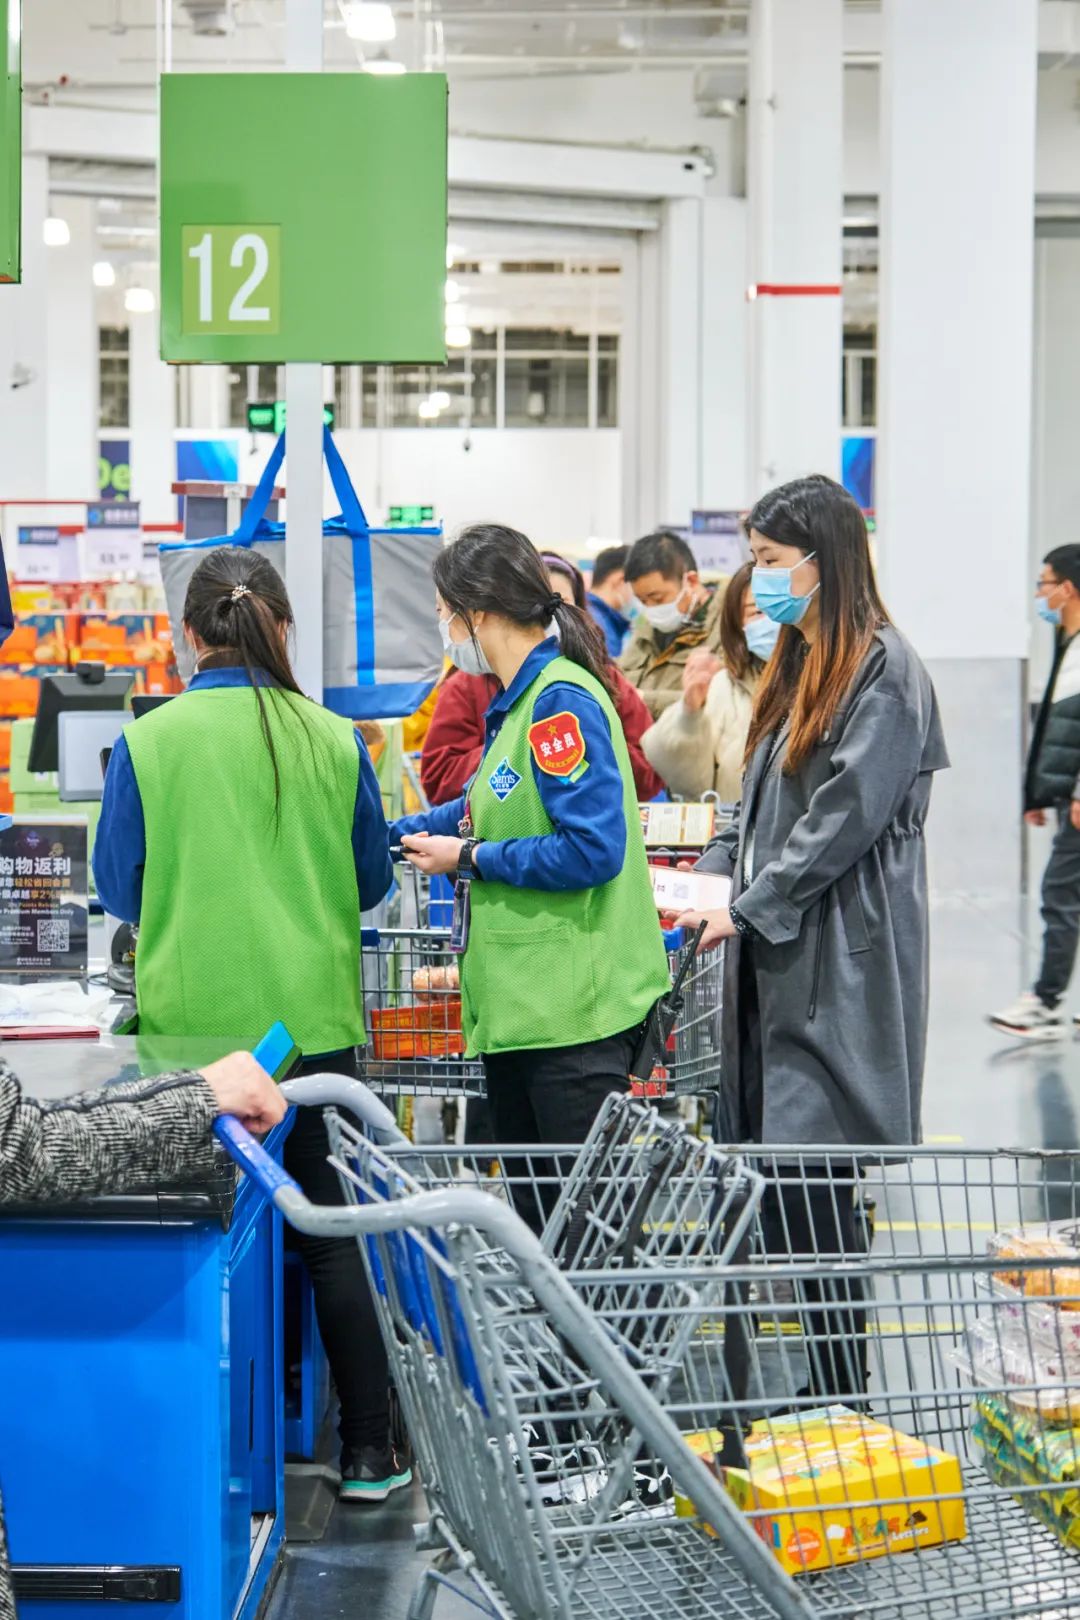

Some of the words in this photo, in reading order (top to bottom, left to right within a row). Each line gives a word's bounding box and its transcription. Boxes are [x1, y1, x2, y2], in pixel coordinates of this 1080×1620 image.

[188, 233, 270, 322] 12
[539, 732, 576, 758] 安全员
[491, 771, 516, 784] Sam's
[0, 857, 71, 875] 购物返利
